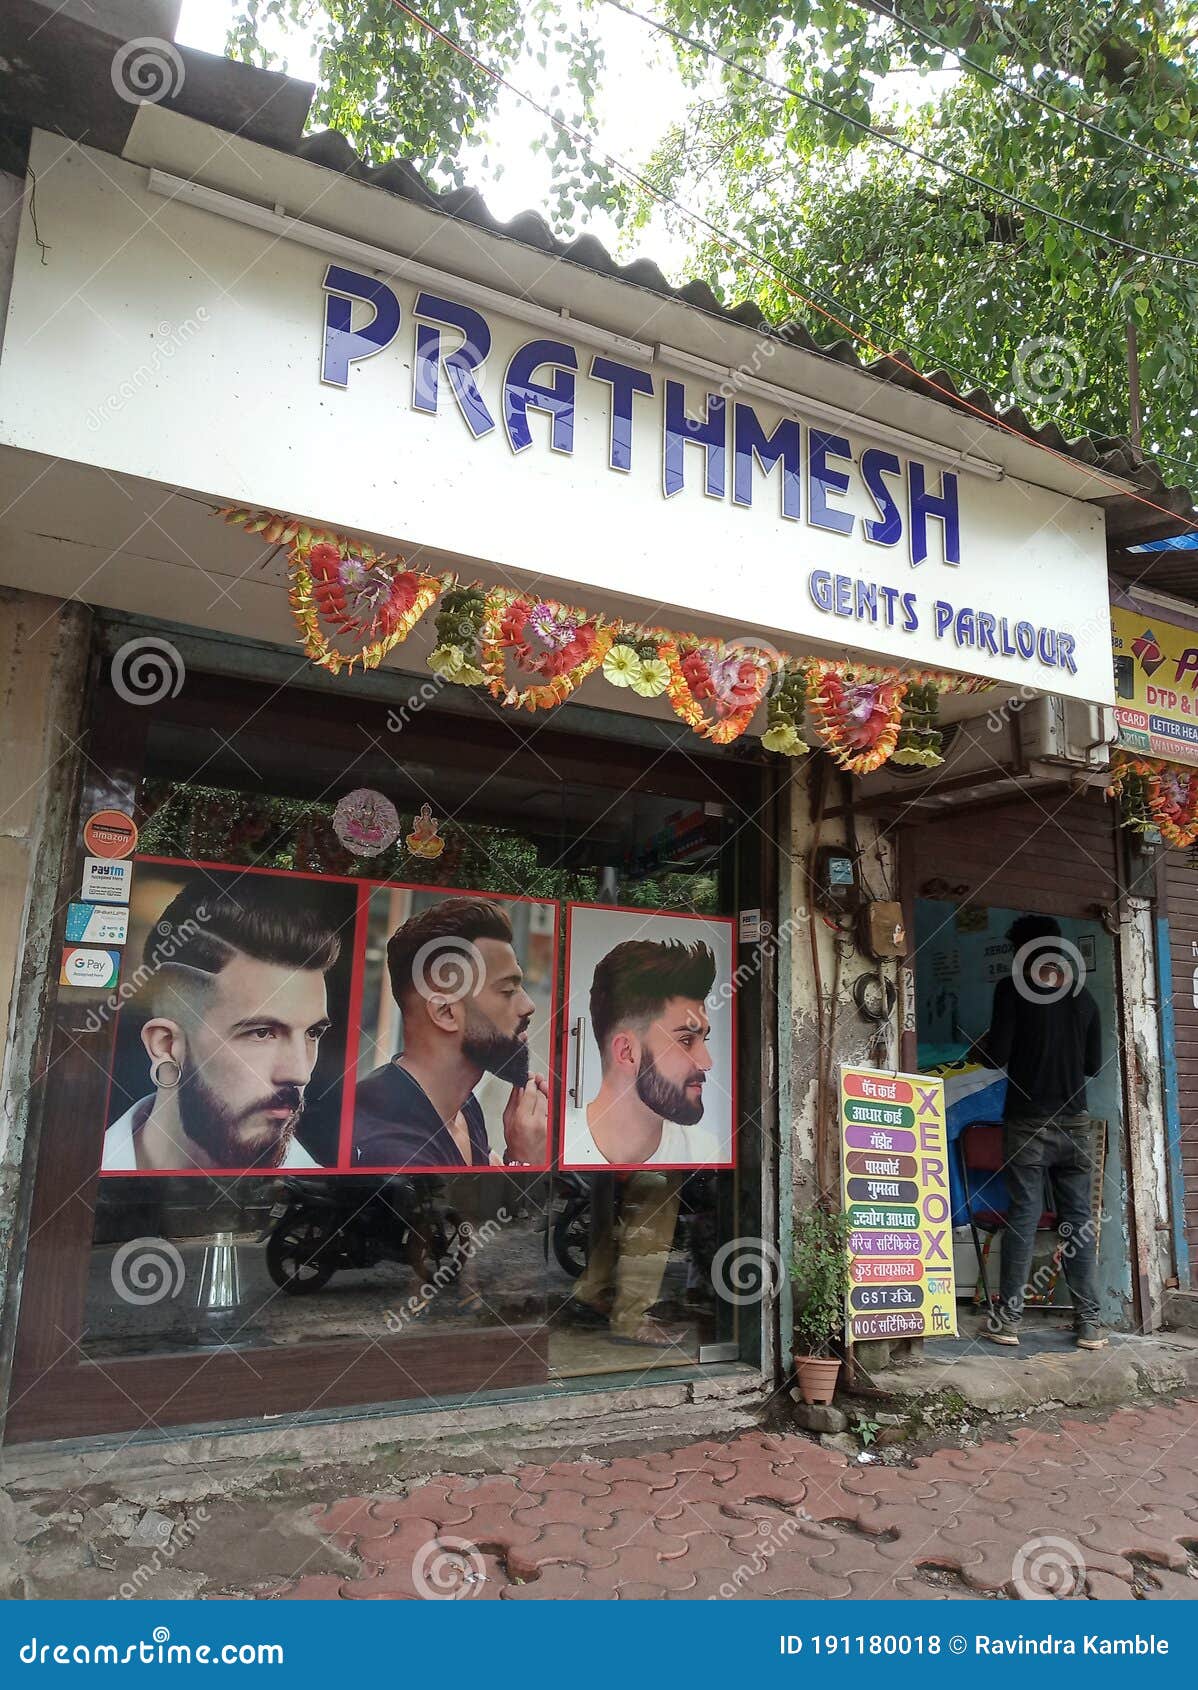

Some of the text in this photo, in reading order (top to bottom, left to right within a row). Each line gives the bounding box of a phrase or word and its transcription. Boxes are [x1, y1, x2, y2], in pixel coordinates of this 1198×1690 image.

[321, 263, 961, 568] PRATHMESH
[809, 569, 1078, 675] GENTS PARLOUR
[1147, 685, 1192, 714] DTP &
[1121, 711, 1146, 727] CARD
[1152, 718, 1198, 740] LETTER HEA
[92, 831, 129, 843] amazon
[74, 957, 106, 972] G Pay
[862, 1079, 897, 1099] पॅन कार्ड
[852, 1106, 903, 1125] आधार कार्ड
[865, 1158, 900, 1176] पासपोर्ट
[916, 1087, 949, 1260] XEROX
[867, 1181, 900, 1200] गुमस्ता
[886, 1213, 916, 1227] आधार
[851, 1233, 920, 1251] मॅरेज सर्टिफिकेट
[873, 1263, 915, 1277] लायसन्स
[927, 1277, 952, 1295] कलर
[878, 1313, 924, 1333] सर्टिफिकेट
[931, 1304, 951, 1331] प्रिंट
